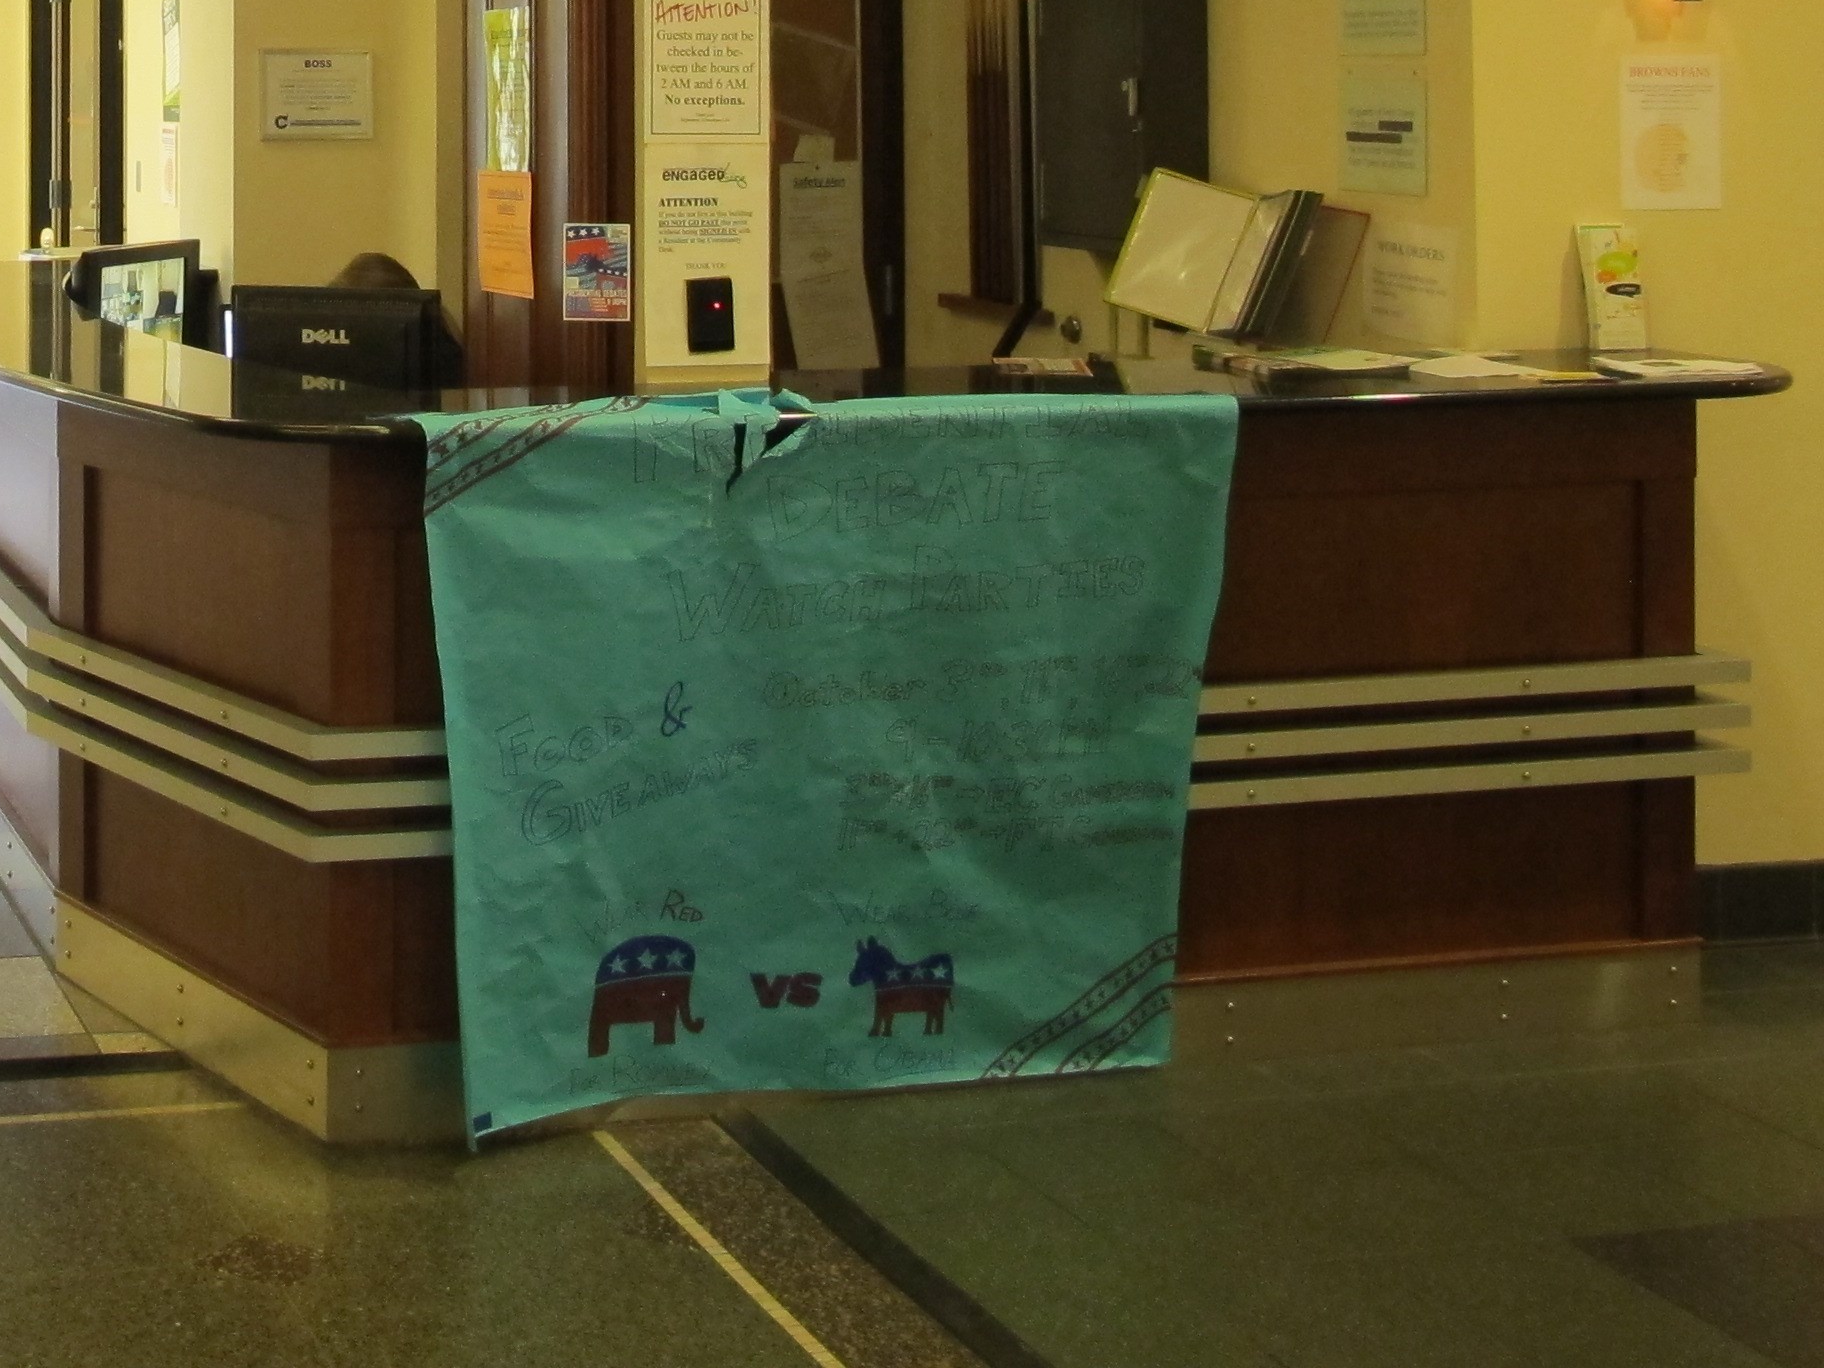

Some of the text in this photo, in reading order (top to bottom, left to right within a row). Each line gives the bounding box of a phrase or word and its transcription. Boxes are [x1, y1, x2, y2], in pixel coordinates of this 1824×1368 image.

[656, 30, 754, 43] Guests may not be
[667, 46, 743, 57] checked in be-
[304, 60, 332, 68] BOSS
[657, 62, 756, 73] tween the hours of
[661, 79, 667, 89] 2
[670, 79, 690, 89] AM
[694, 78, 713, 89] and
[716, 78, 723, 89] 6
[665, 94, 745, 108] No exceptions.
[658, 197, 718, 207] ATTENTION
[301, 328, 351, 344] DELL
[766, 461, 1065, 543] DEBATE
[667, 544, 1145, 642] WATCH PARTIES
[495, 680, 693, 777] FOOD &
[521, 738, 759, 846] GIVEAWAYS
